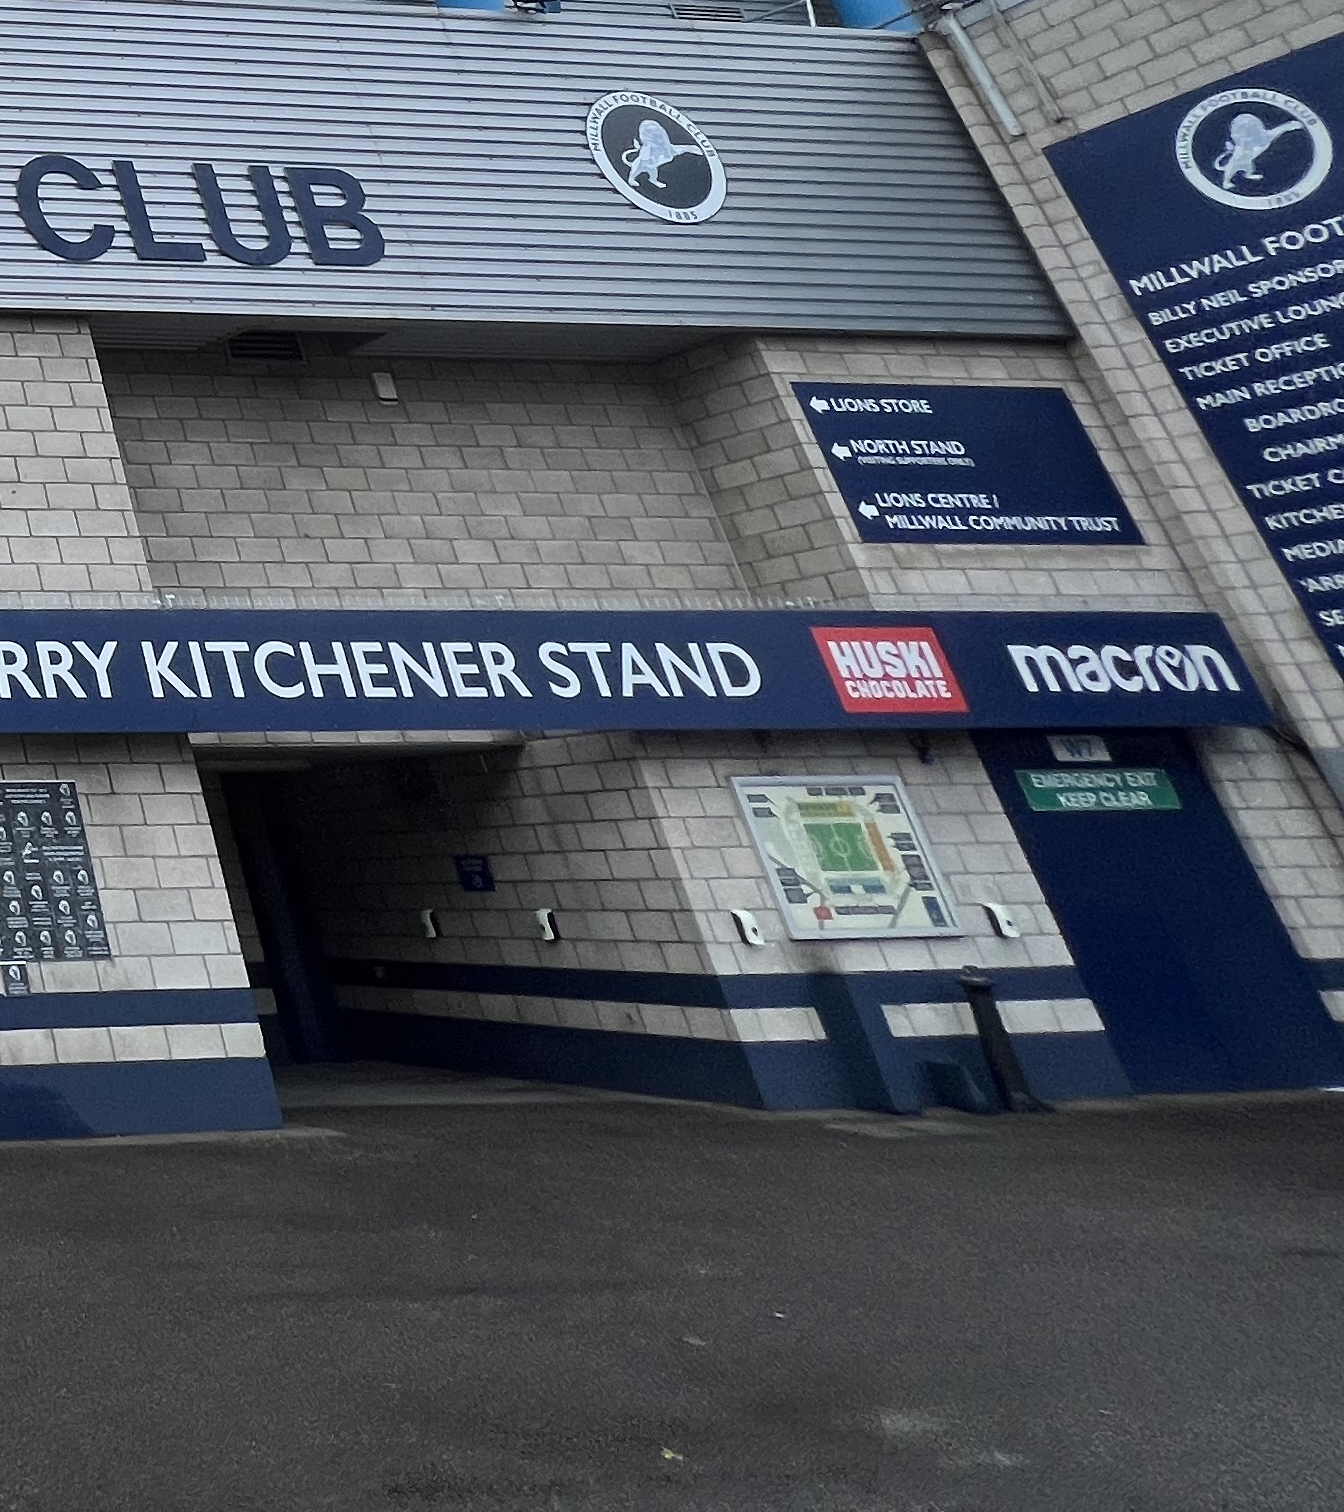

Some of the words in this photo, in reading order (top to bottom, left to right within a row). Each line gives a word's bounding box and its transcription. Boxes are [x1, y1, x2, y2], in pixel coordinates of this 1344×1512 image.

[589, 99, 614, 152] MILLWALL
[613, 93, 682, 123] FOOTBALL
[14, 154, 387, 268] CLUB
[1128, 246, 1265, 296] MILLWALL
[1147, 301, 1198, 326] BILLY
[1199, 289, 1249, 311] NEIL
[1163, 314, 1276, 353] EXECUTIVE
[1178, 353, 1250, 381] TICKET
[1254, 333, 1330, 363] OFFICE
[830, 397, 878, 413] LIONS
[883, 399, 933, 414] STORE
[1196, 387, 1252, 410] MAIN
[849, 439, 908, 455] NORTH
[911, 440, 965, 456] STAND
[875, 492, 925, 508] LIONS
[928, 493, 993, 509] CENTRE
[1246, 472, 1321, 499] TICKET
[885, 515, 966, 531] MILLWALL
[969, 515, 1069, 532] COMMUNITY
[1072, 516, 1120, 532] TRUST
[141, 640, 533, 700] KITCHENER
[538, 641, 763, 699] STAND
[827, 640, 943, 678] HUSKI
[1007, 644, 1241, 693] macron
[845, 680, 953, 699] CHOCOLATE
[1030, 773, 1123, 788] EMERGENCY
[1124, 772, 1158, 787] EXIT
[1057, 792, 1097, 808] KEEP
[1099, 791, 1153, 807] CLEAR
